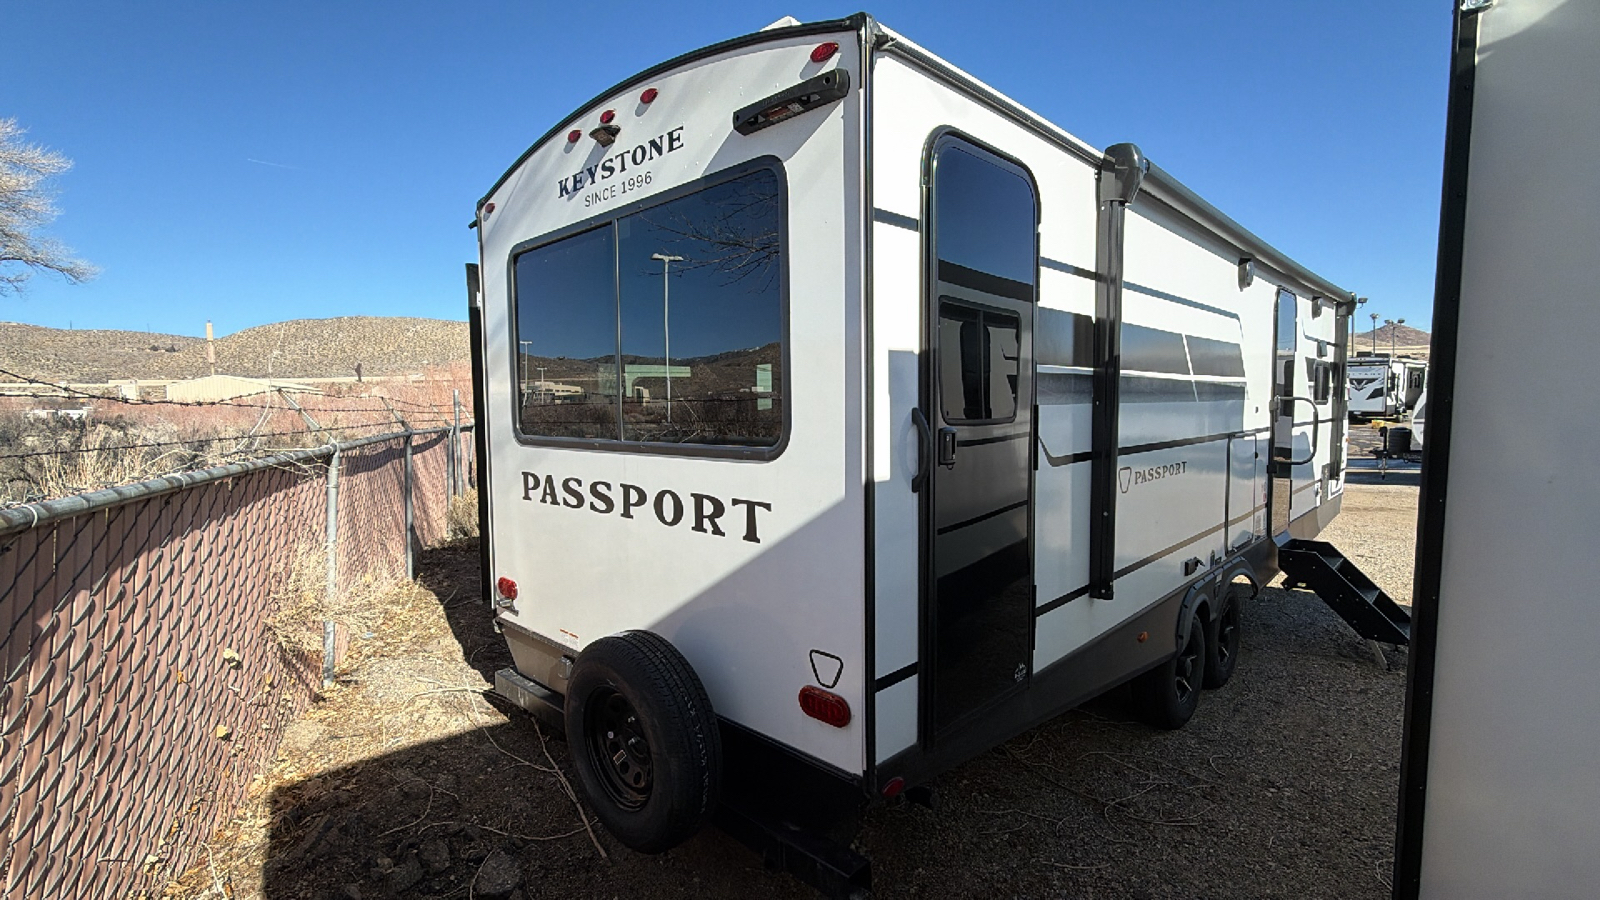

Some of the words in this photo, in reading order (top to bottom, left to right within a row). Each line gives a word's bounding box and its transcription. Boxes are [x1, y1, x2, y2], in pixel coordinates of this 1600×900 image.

[558, 126, 684, 198] KEYSTONE
[585, 185, 616, 207] SINCE
[621, 171, 652, 194] 1996
[1135, 461, 1187, 485] PASSPORT
[521, 471, 772, 544] PASSPORT
